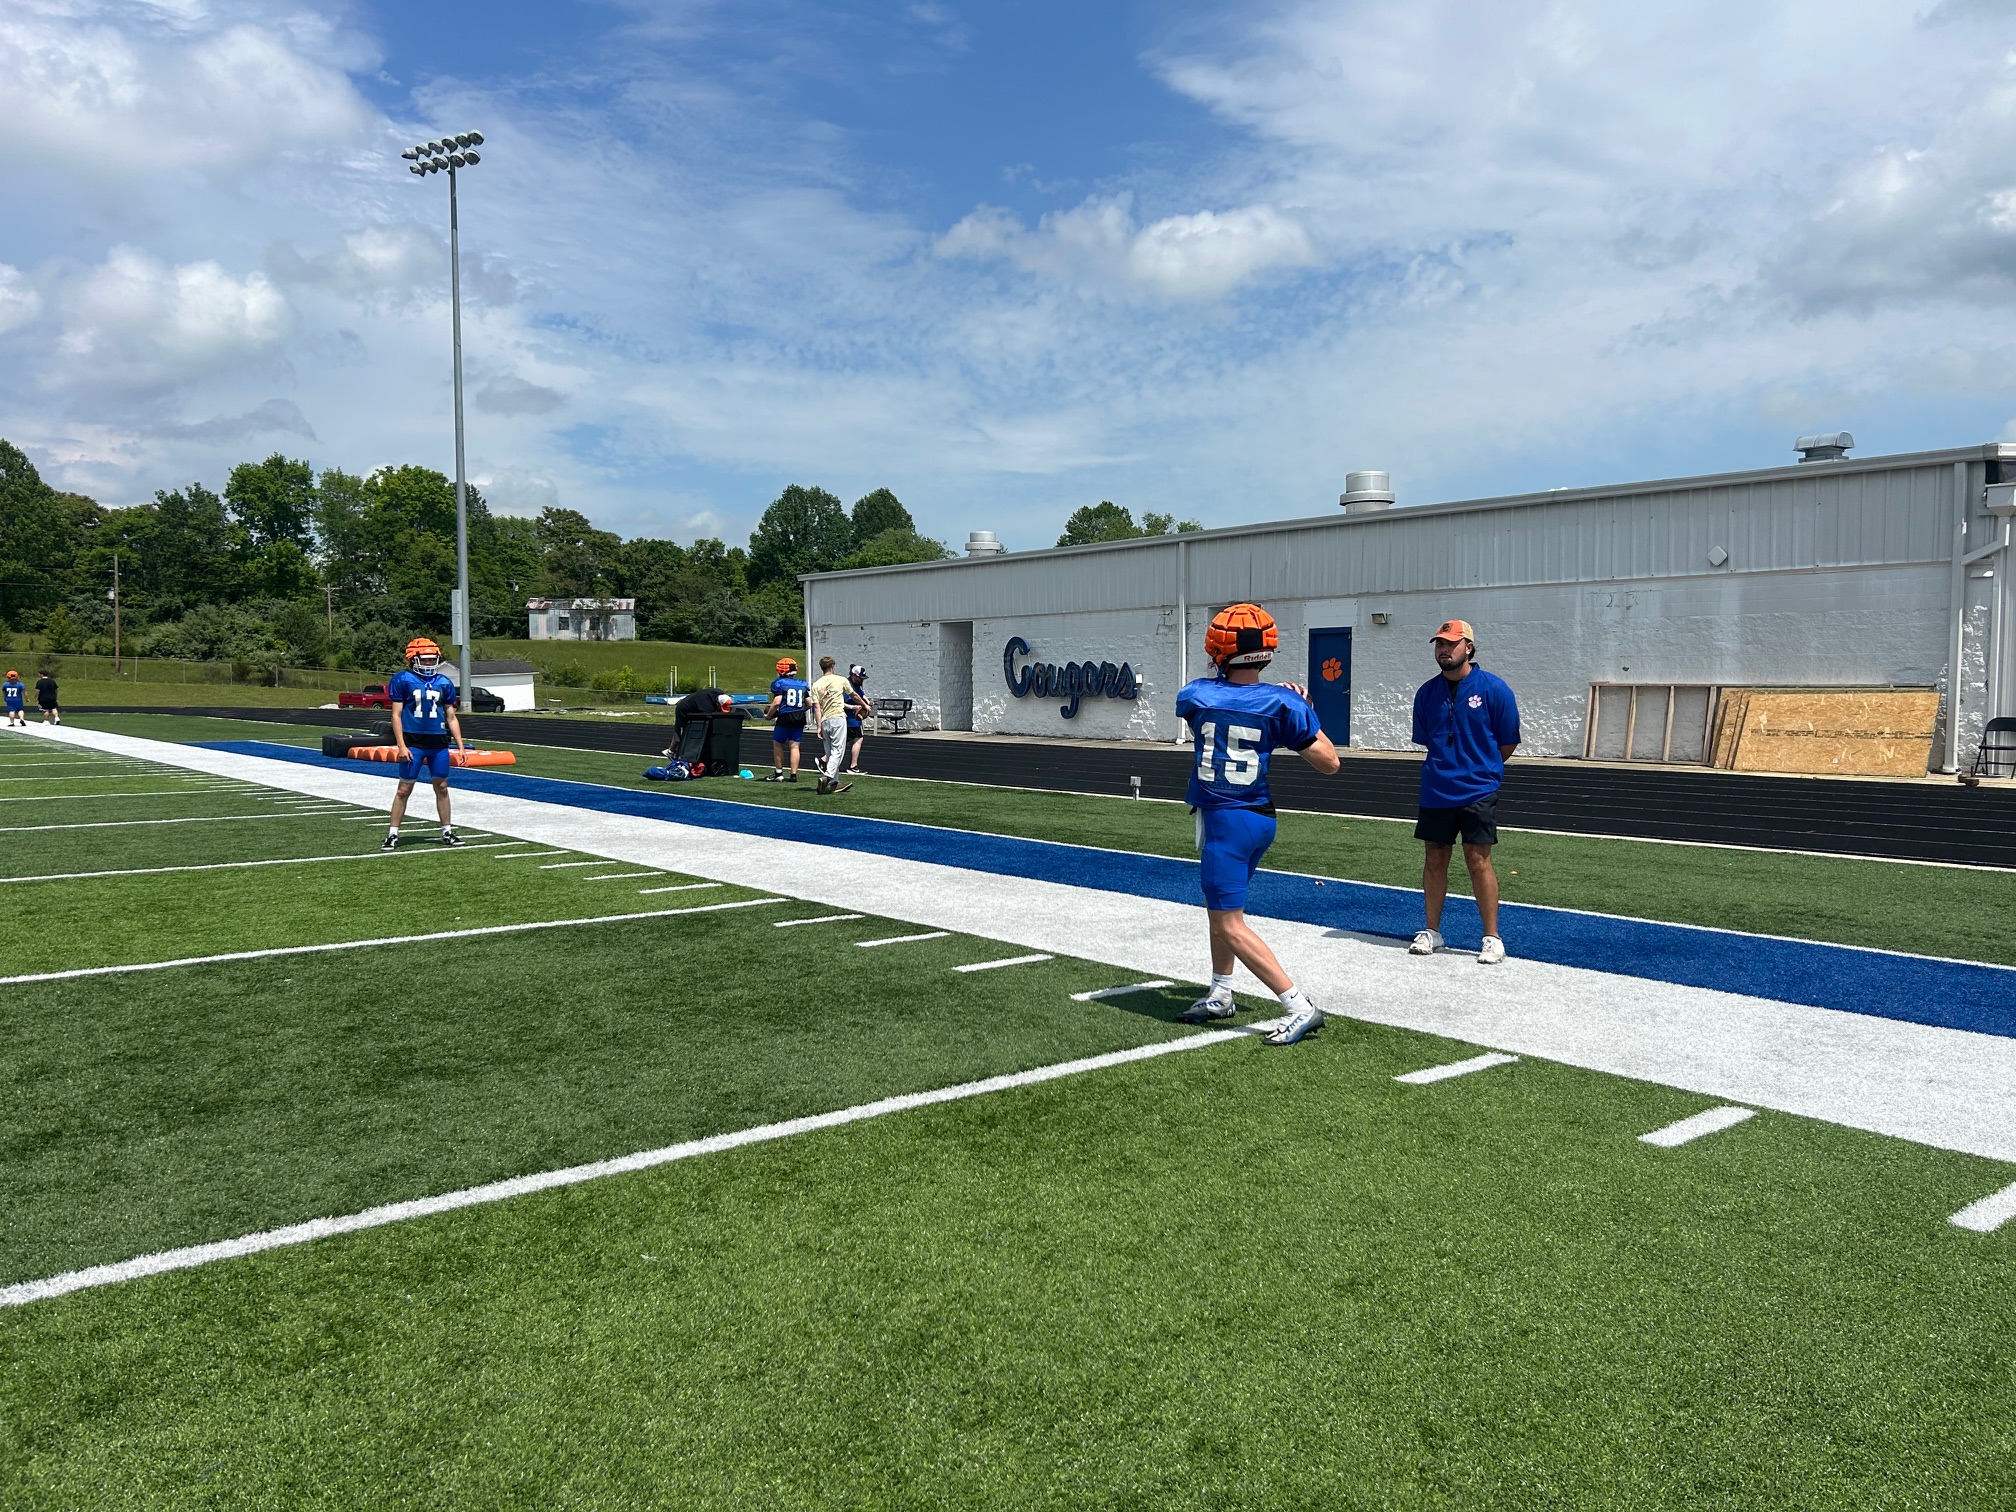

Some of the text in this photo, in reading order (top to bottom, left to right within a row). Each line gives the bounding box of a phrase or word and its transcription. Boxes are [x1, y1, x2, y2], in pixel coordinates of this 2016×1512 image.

[1003, 636, 1137, 719] Cougars
[6, 688, 18, 697] 77
[413, 689, 440, 718] 17
[786, 688, 803, 708] 81
[1198, 722, 1262, 785] 15
